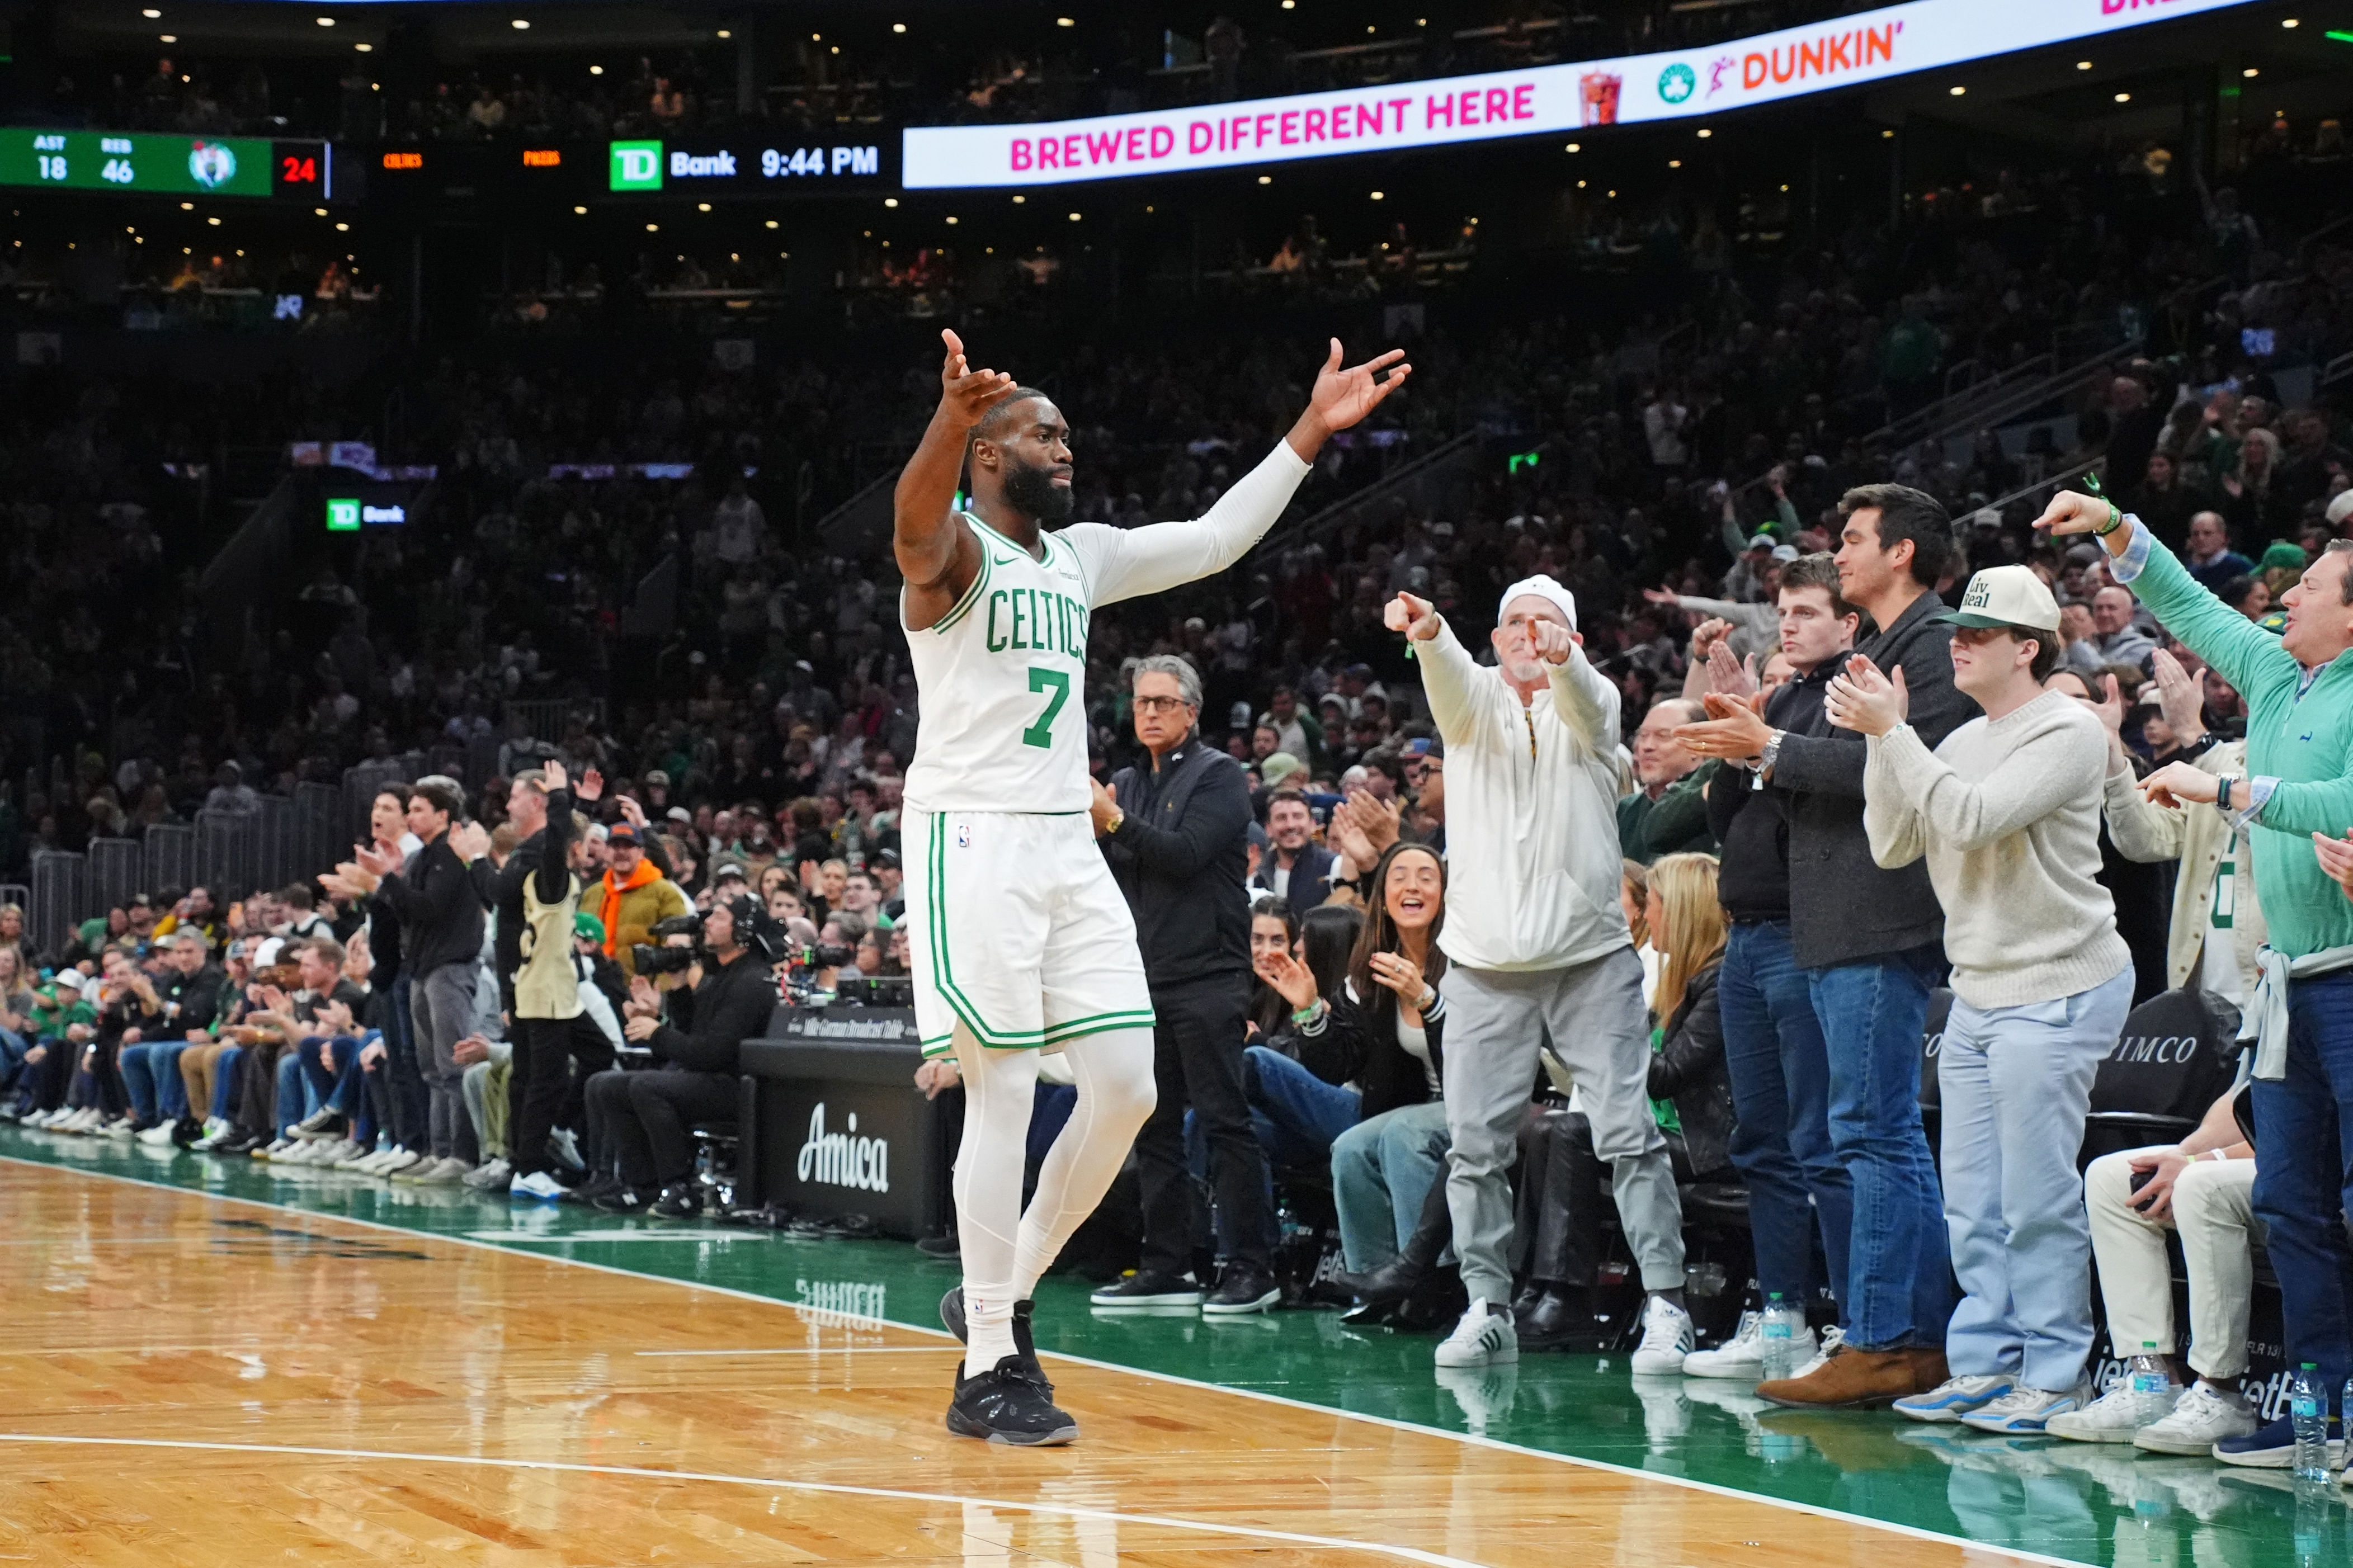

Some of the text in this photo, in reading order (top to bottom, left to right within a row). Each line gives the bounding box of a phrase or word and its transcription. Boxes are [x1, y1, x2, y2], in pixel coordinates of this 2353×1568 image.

[1743, 21, 1904, 90] DUNKIN'
[1011, 84, 1534, 171] BREWED DIFFERENT HERE
[38, 155, 67, 180] 18
[101, 159, 134, 183] 46
[283, 157, 316, 182] 24
[616, 149, 737, 181] TD Bank
[761, 145, 878, 177] 9:44 PM
[331, 504, 358, 525] TD
[1962, 593, 1990, 608] Real
[1022, 667, 1069, 749] 7
[2115, 1036, 2198, 1064] IMCO
[798, 1101, 889, 1193] Amica
